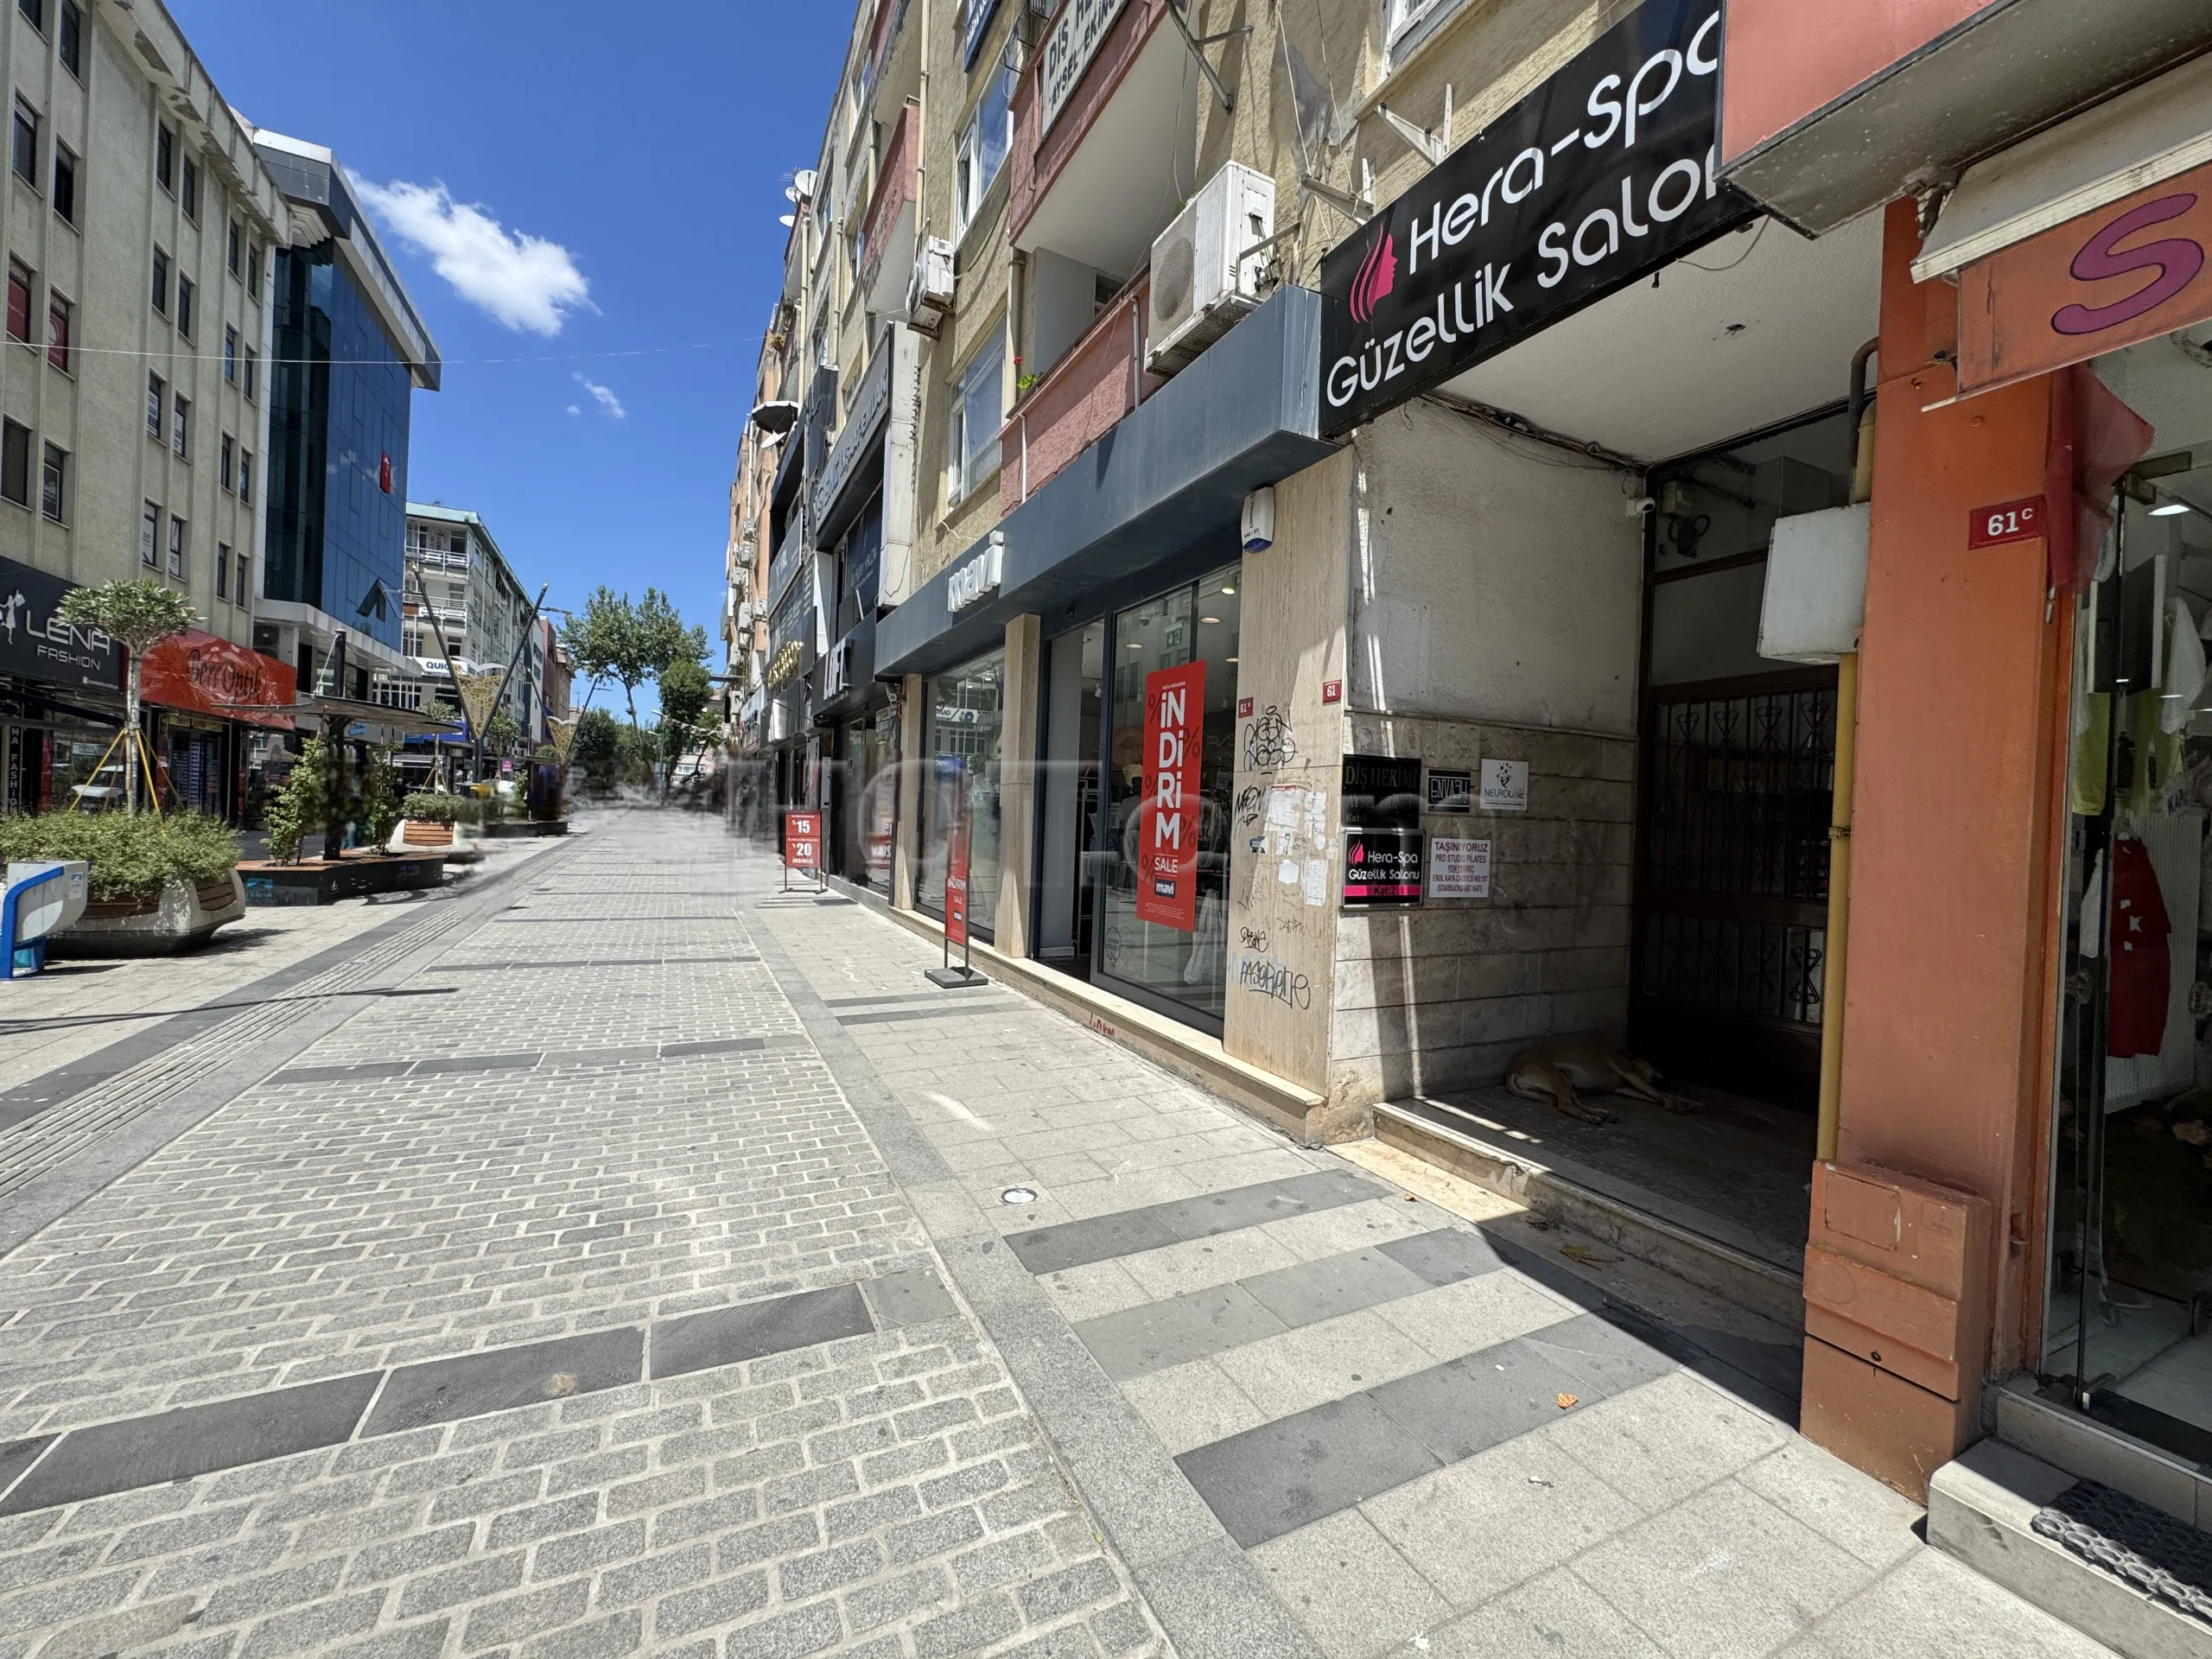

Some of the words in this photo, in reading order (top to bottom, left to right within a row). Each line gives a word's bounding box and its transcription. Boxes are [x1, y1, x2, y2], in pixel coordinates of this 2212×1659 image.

[1049, 17, 1069, 81] DİŞ
[1052, 50, 1078, 111] AYSEL
[1327, 263, 1515, 407] Güzellik
[948, 531, 1003, 612] mavi
[27, 610, 110, 656] LENA
[37, 645, 100, 671] FASHION
[823, 637, 848, 701] LOFT
[1326, 685, 1336, 697] 61
[1344, 762, 1368, 790] DİŞ
[1370, 765, 1416, 787] HEKİMİ
[1154, 856, 1178, 873] SALE
[1368, 851, 1418, 867] Hera-Spa
[1435, 854, 1446, 862] PRO
[1349, 868, 1386, 880] Güzellik
[1389, 869, 1420, 880] Salonu
[1156, 882, 1174, 895] mavi
